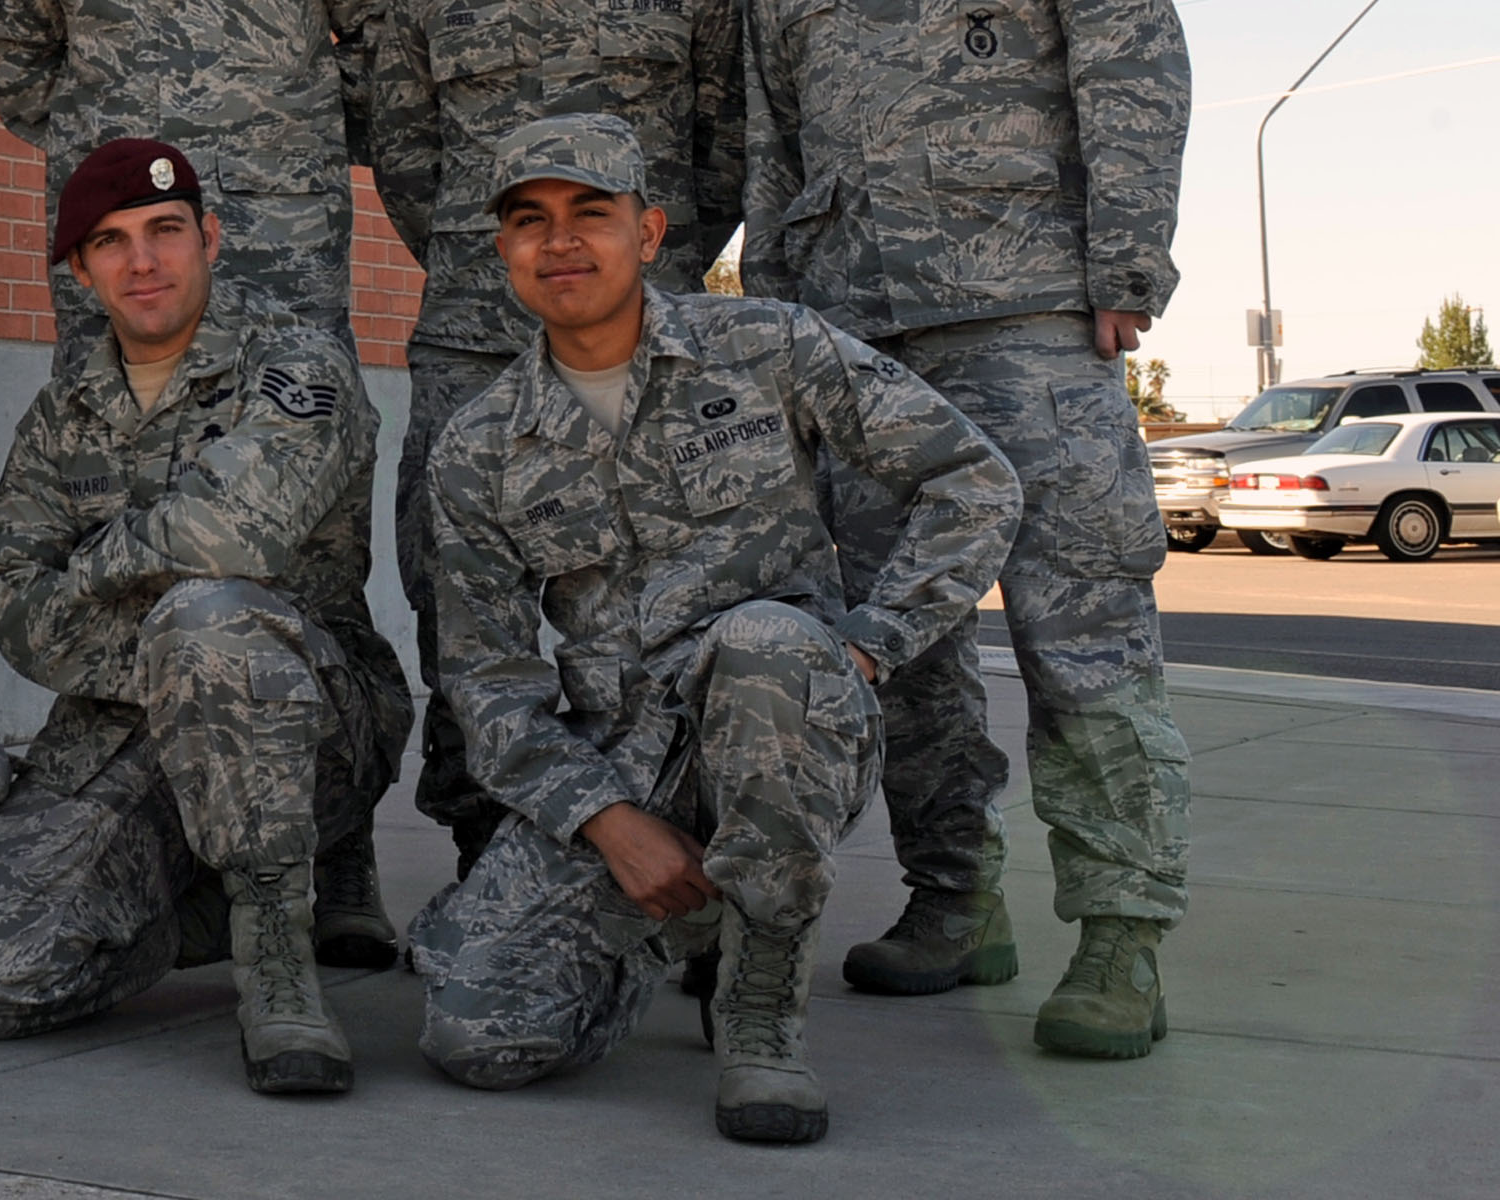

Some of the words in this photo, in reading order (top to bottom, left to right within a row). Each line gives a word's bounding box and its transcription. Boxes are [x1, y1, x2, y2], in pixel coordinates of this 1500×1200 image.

[704, 429, 730, 453] AIR
[728, 415, 778, 444] FORCE
[63, 476, 109, 497] RNARD
[525, 497, 565, 524] BRAVO
